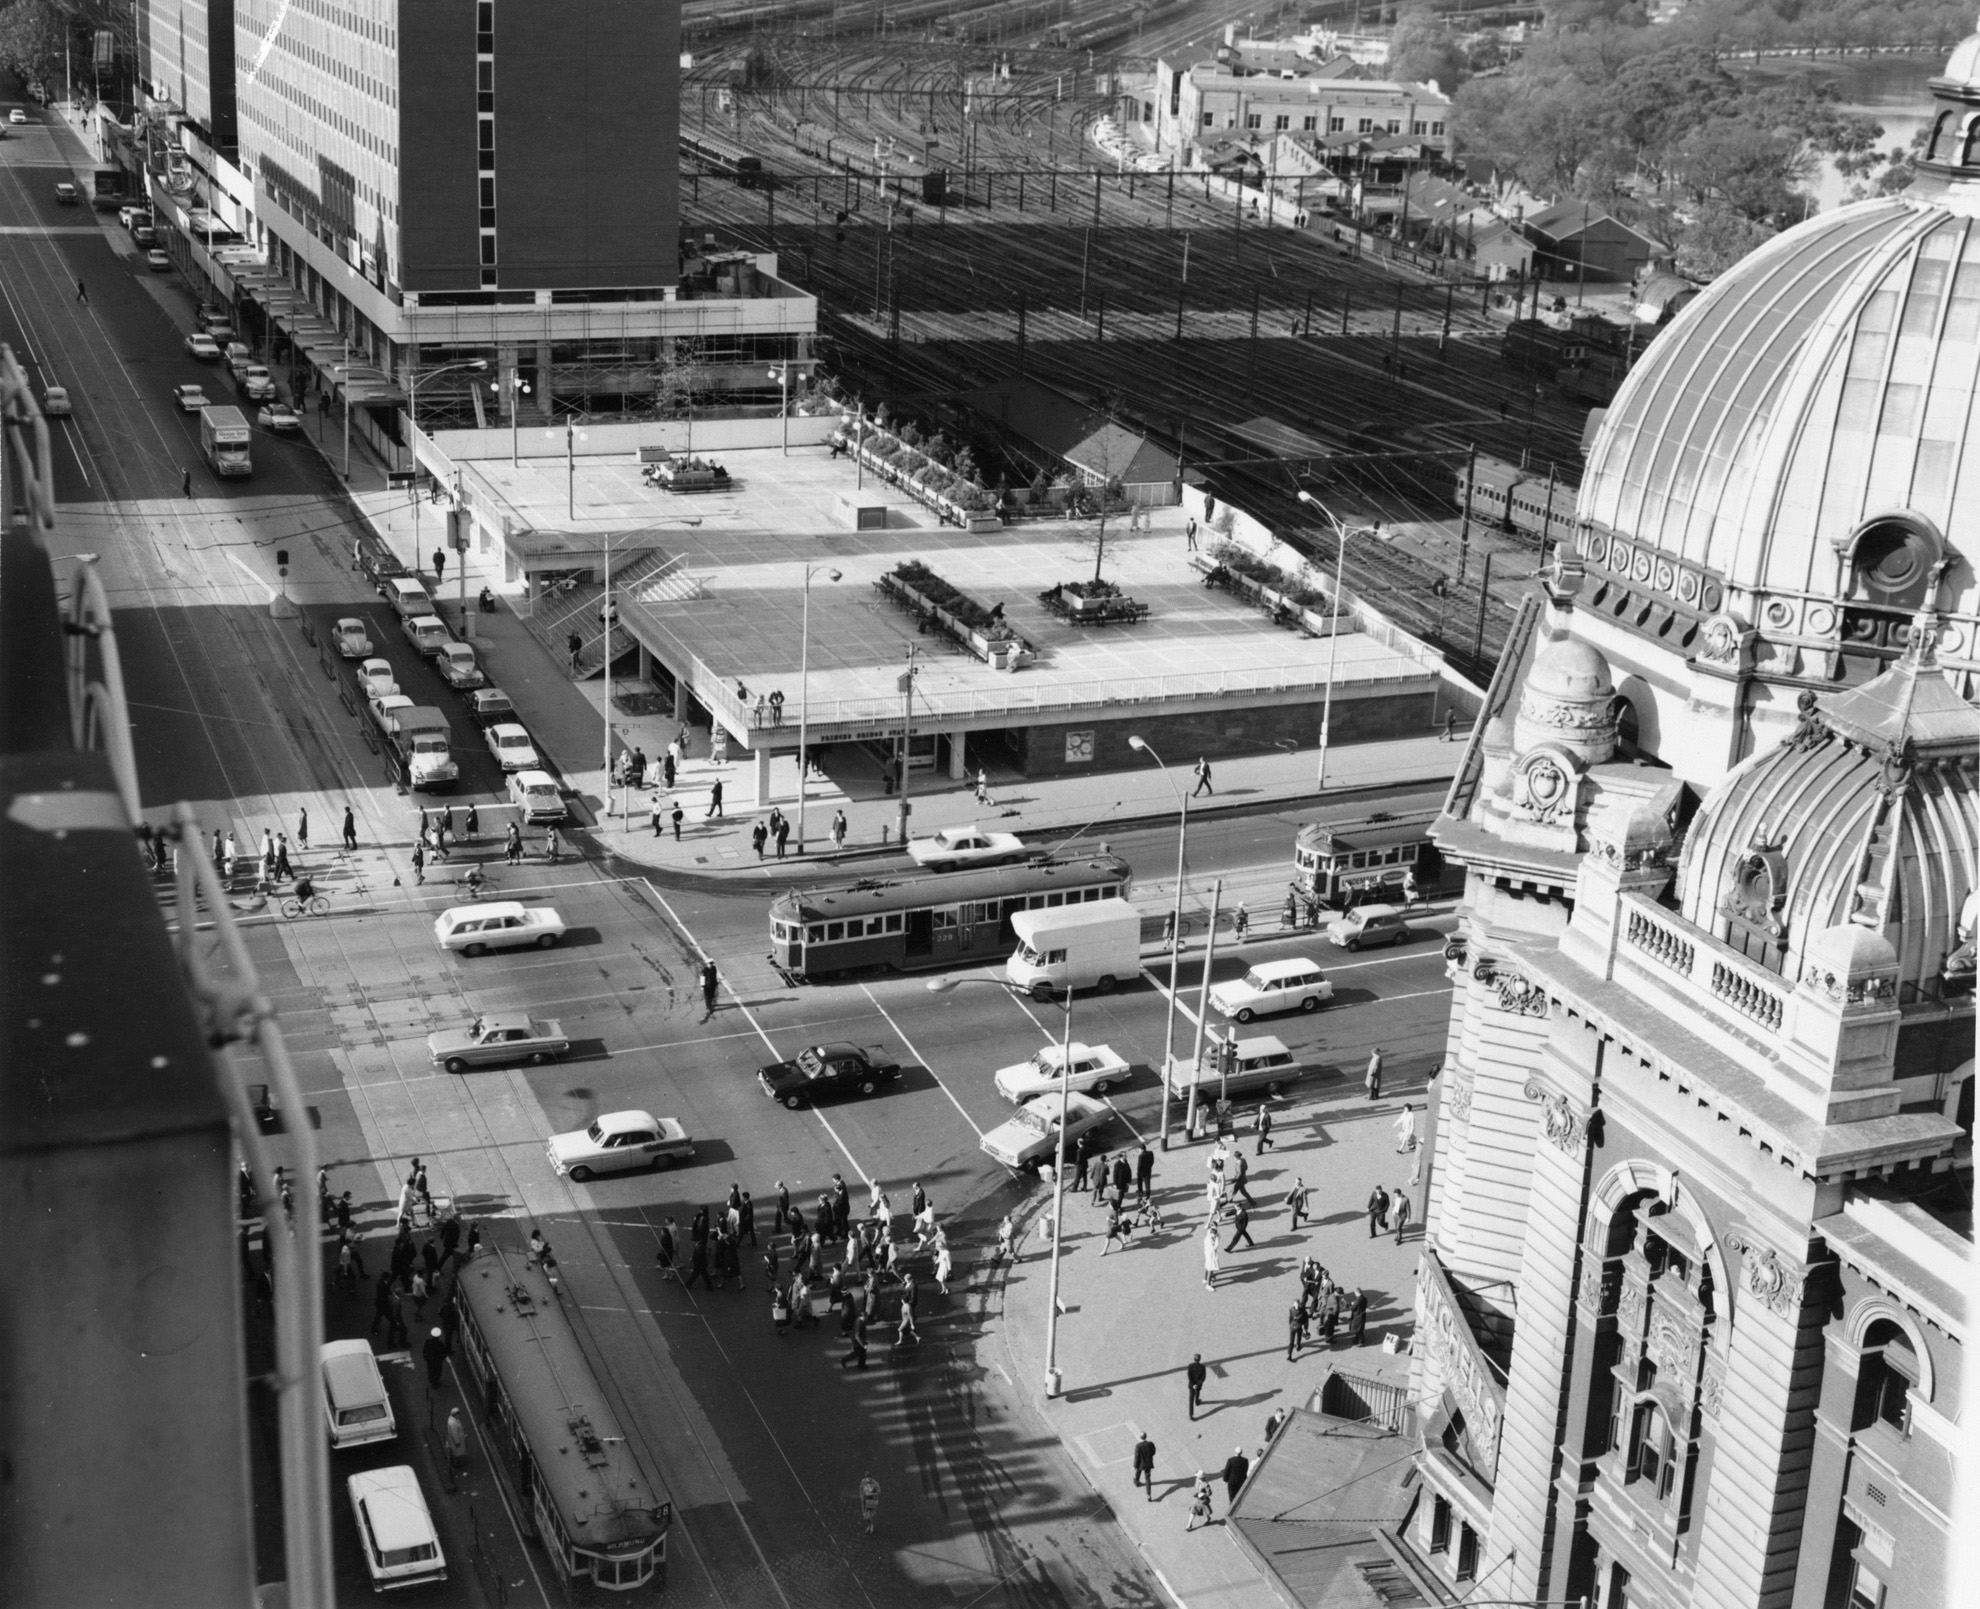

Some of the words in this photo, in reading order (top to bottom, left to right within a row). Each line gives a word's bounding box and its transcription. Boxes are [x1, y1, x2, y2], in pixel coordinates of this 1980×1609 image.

[889, 728, 918, 737] STATON
[1341, 875, 1378, 887] LNDEMANS
[656, 1505, 669, 1519] 28
[606, 1538, 645, 1550] RICHMOND
